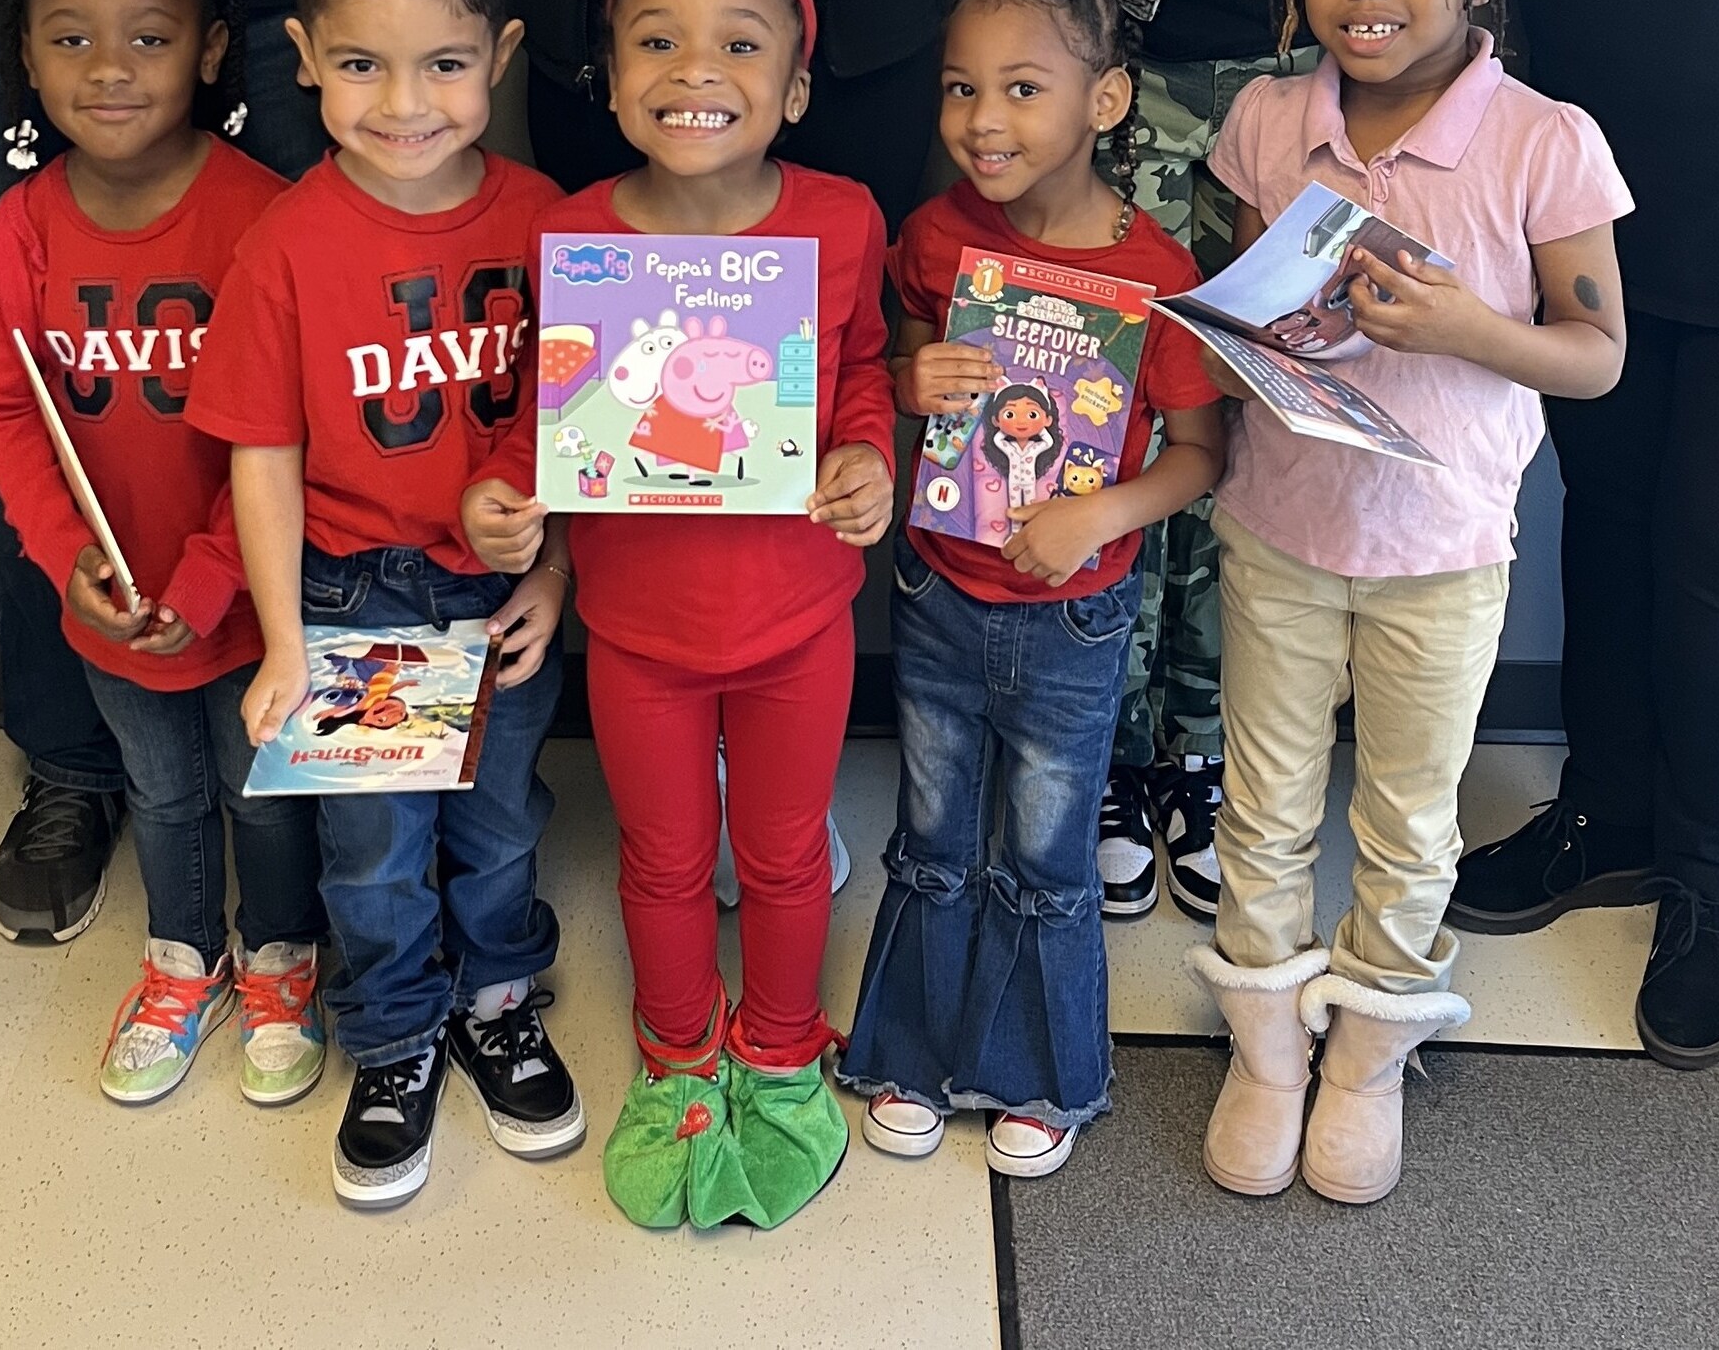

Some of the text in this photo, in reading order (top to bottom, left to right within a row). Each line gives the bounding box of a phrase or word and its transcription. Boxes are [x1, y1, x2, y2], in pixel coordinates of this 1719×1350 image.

[555, 249, 628, 278] Peppa Pig
[645, 249, 784, 285] Peppa's BIG
[982, 268, 994, 292] 1
[1027, 267, 1114, 297] SCHOLASTIC
[675, 283, 753, 312] Feelings
[992, 314, 1101, 359] SLEEPOVER
[1013, 343, 1072, 376] PARTY
[641, 495, 721, 504] SCHOLASTIC
[937, 484, 950, 503] N
